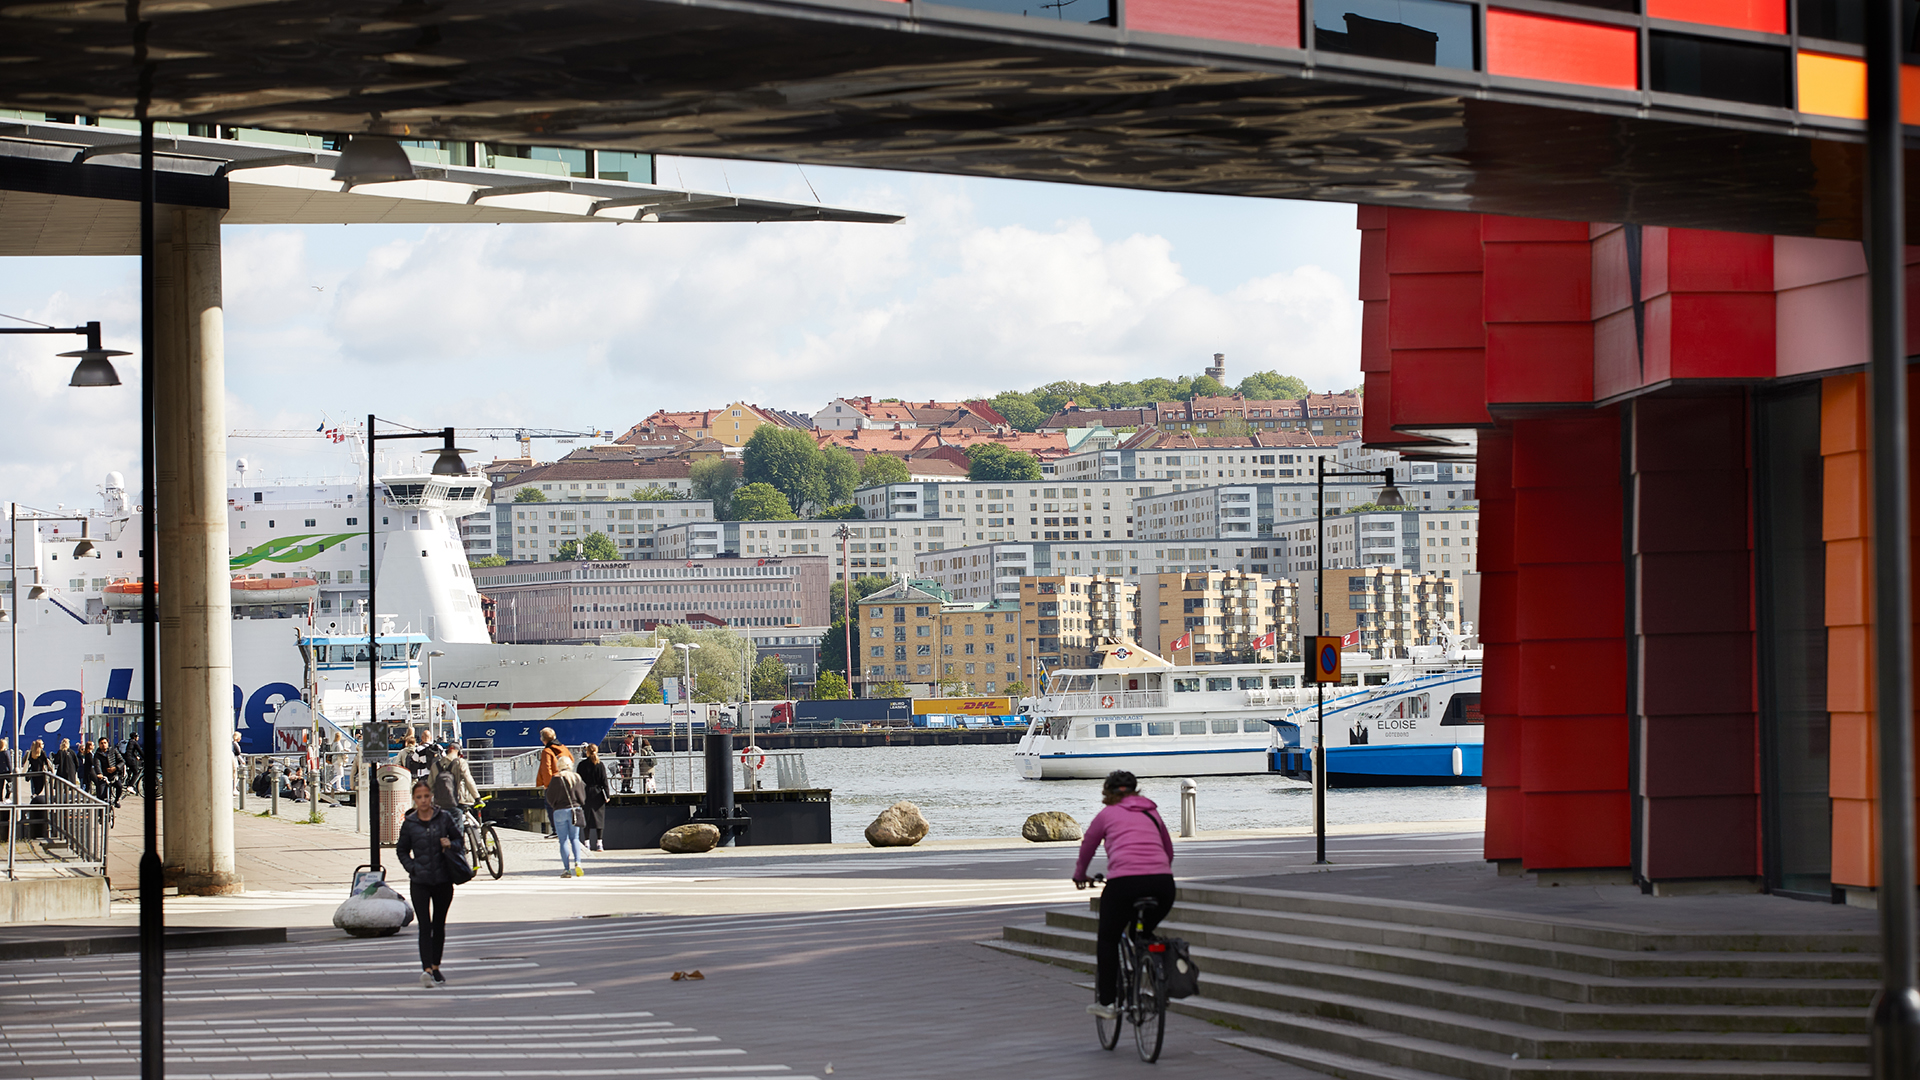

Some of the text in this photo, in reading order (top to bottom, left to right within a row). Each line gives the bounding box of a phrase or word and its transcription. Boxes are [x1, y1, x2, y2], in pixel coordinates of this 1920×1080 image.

[345, 681, 396, 692] ÄLVFIDA
[420, 680, 500, 690] TANDICA
[963, 701, 997, 710] DHL
[1377, 720, 1416, 729] ELOISE
